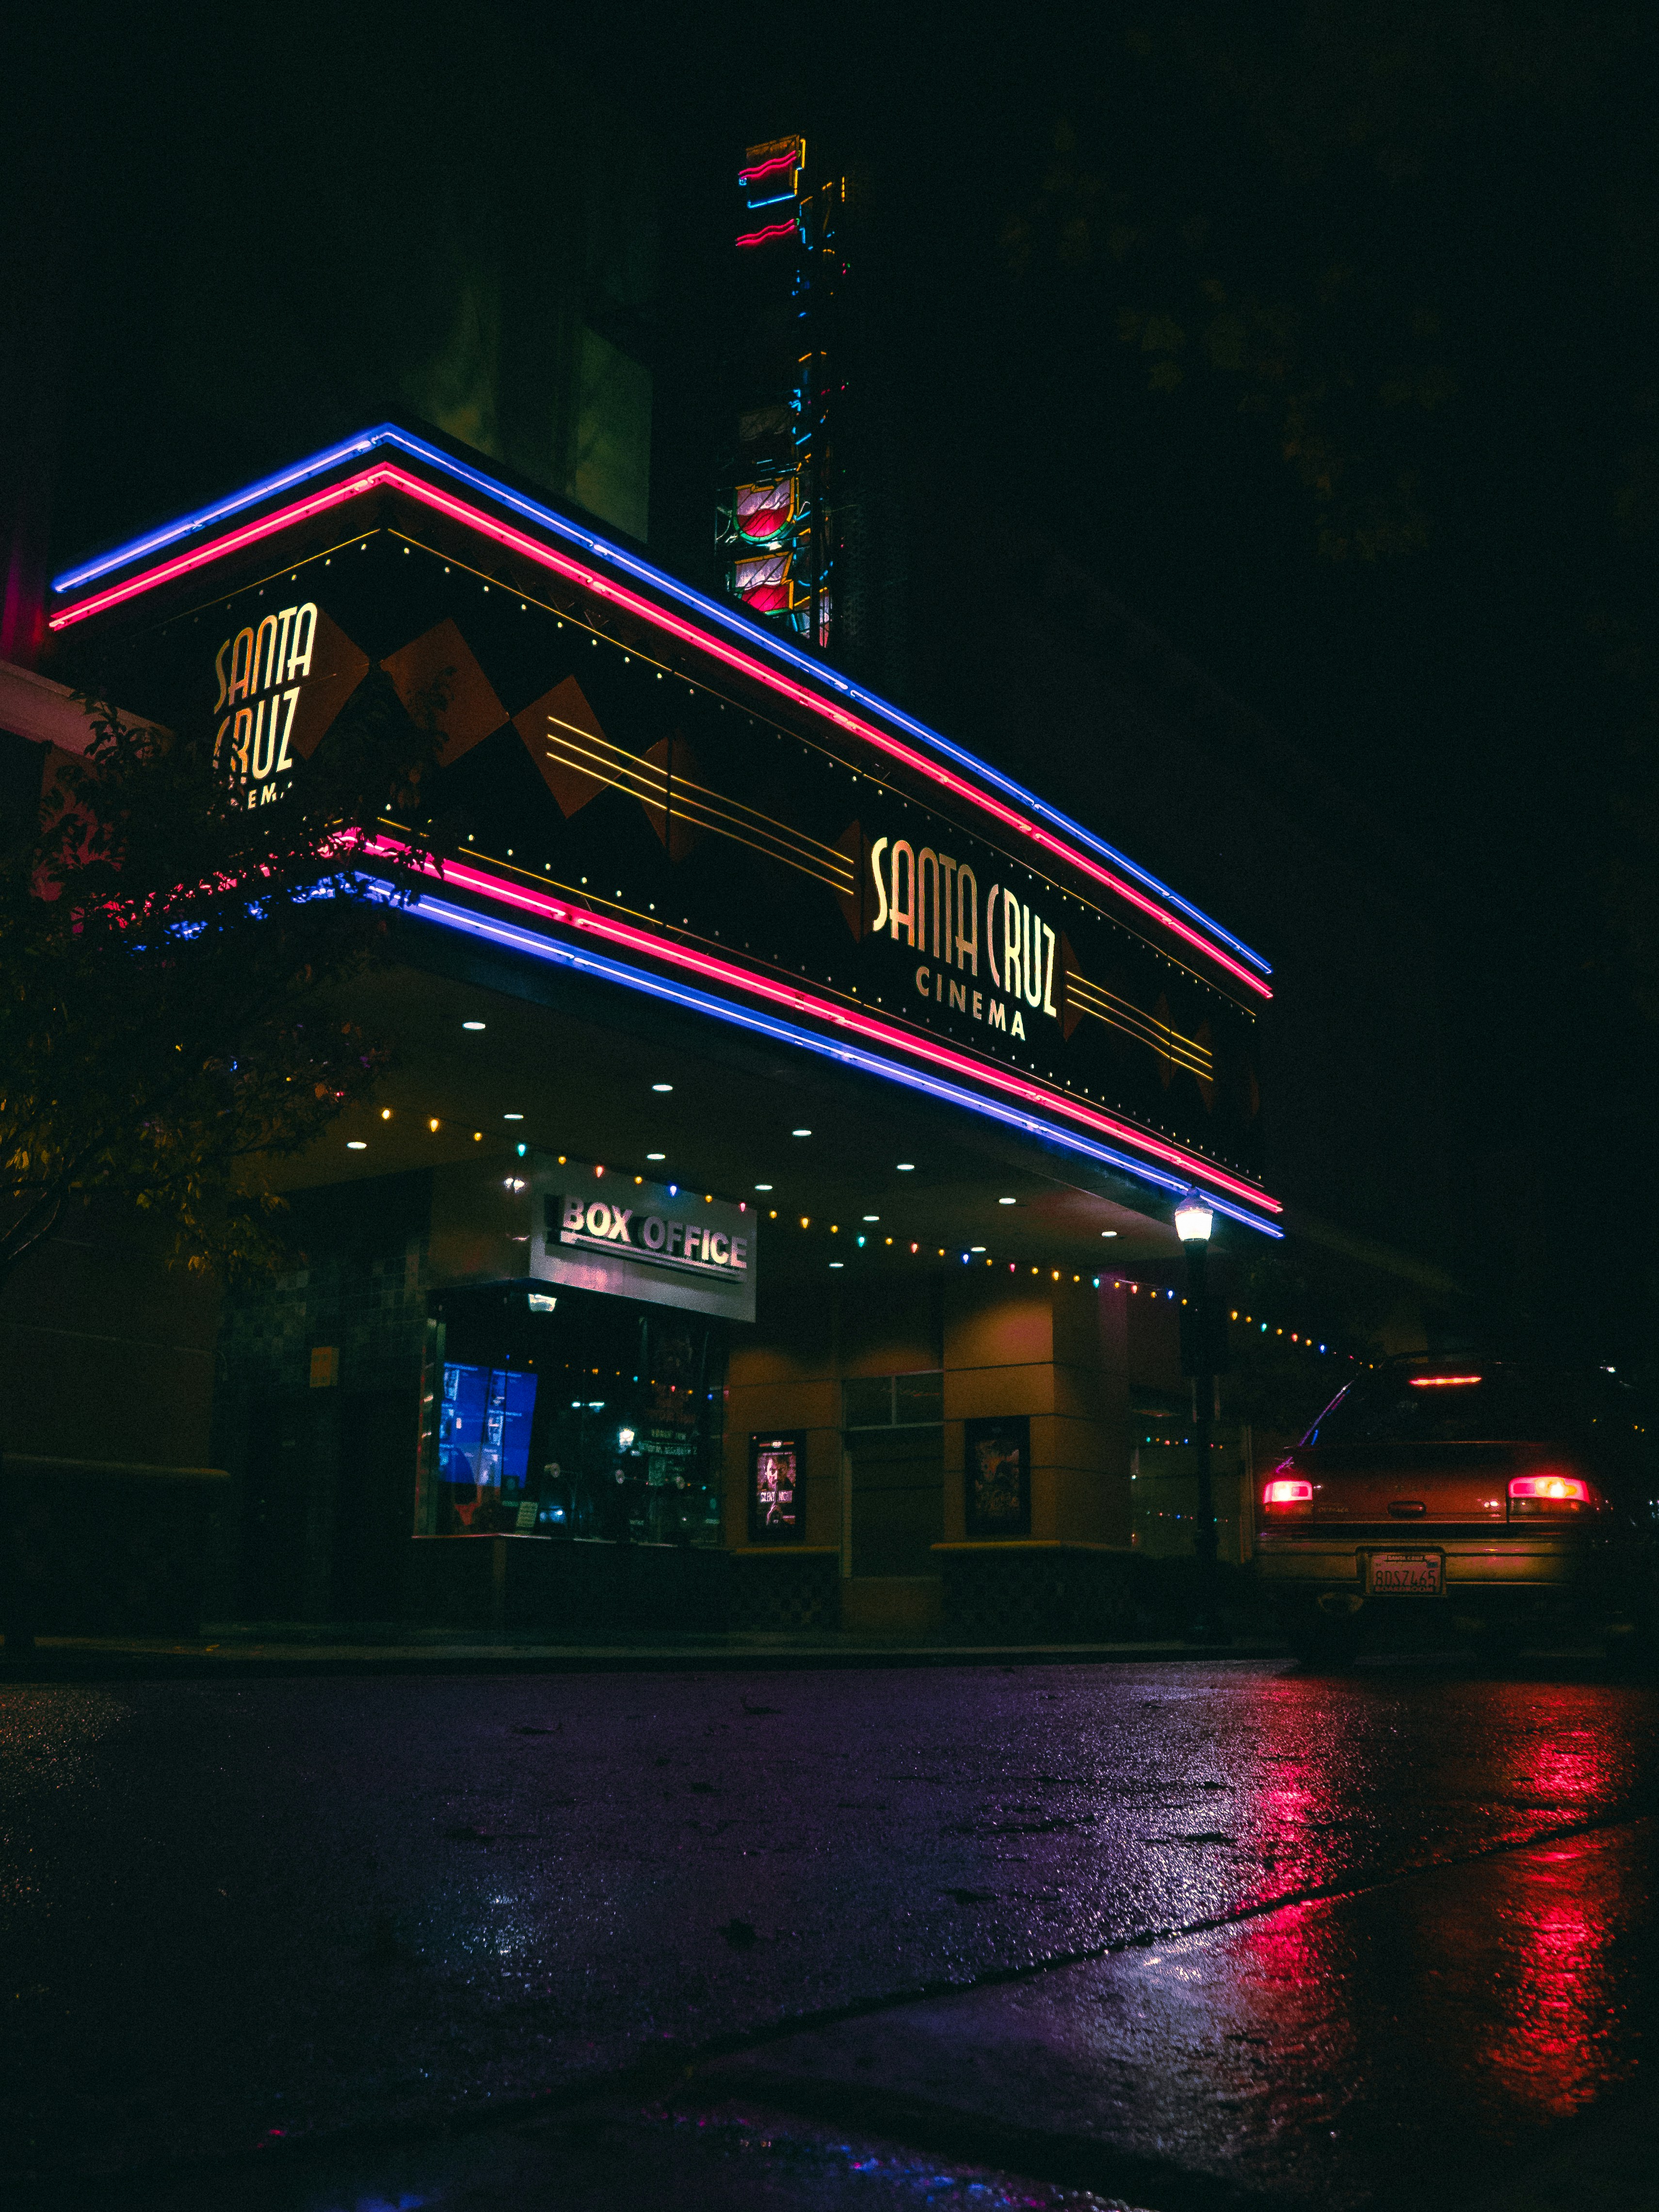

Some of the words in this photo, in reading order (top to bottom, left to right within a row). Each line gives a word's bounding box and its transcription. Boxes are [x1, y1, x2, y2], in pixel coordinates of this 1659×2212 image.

[213, 602, 318, 714] SANTA
[871, 837, 978, 977] SANTA
[986, 884, 1057, 1018] CRUZ
[916, 966, 1026, 1041] CINEMA
[563, 1194, 633, 1243] BOX
[643, 1216, 748, 1269] OFFICE
